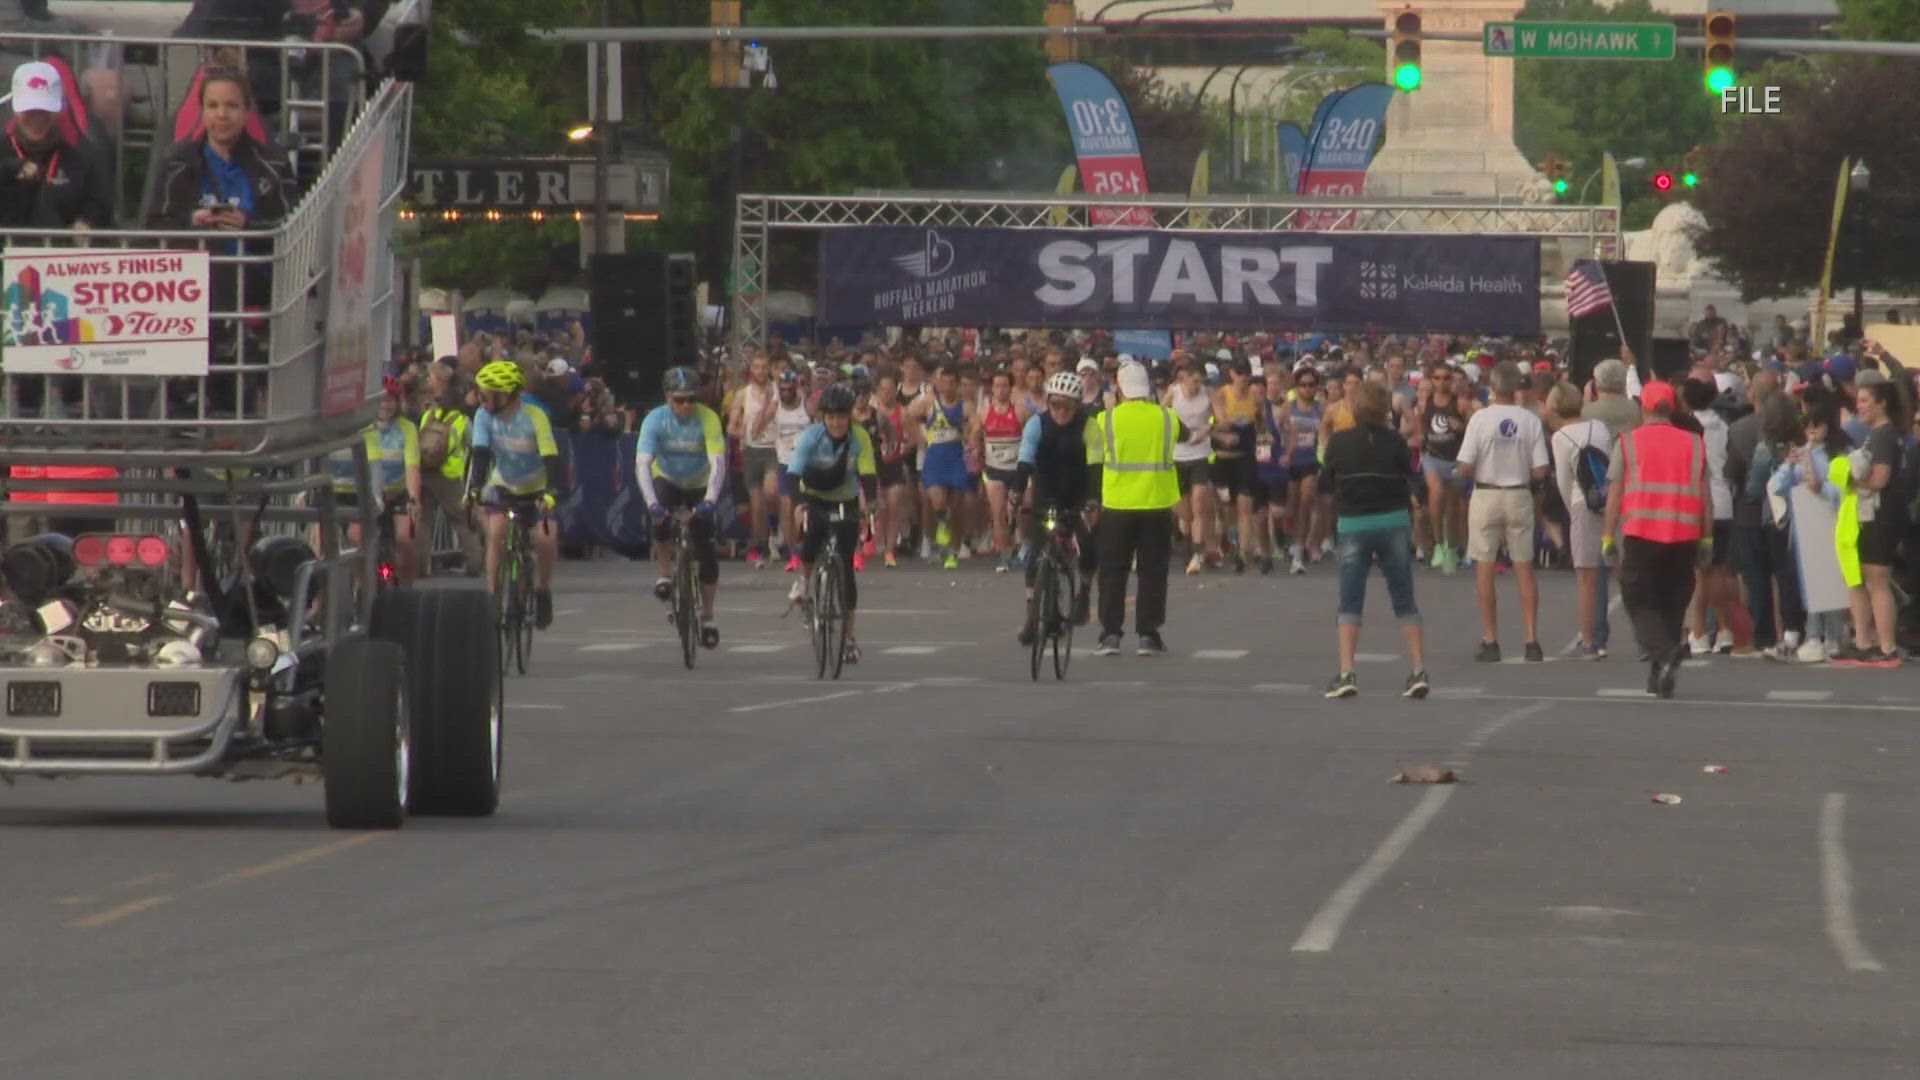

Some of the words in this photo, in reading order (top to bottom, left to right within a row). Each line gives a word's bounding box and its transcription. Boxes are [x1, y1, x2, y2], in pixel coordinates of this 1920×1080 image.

[1521, 31, 1537, 48] W
[1548, 32, 1638, 50] MOHAWK
[1321, 117, 1376, 150] 3:40
[46, 262, 111, 276] ALWAYS
[118, 258, 182, 274] FINISH
[1034, 237, 1333, 306] START
[73, 280, 201, 306] STRONG
[874, 283, 922, 310] BUFFALO
[926, 270, 987, 297] MARATHON
[1403, 275, 1464, 293] Kaleida
[1469, 276, 1522, 294] Health
[902, 294, 955, 320] WEEKEND
